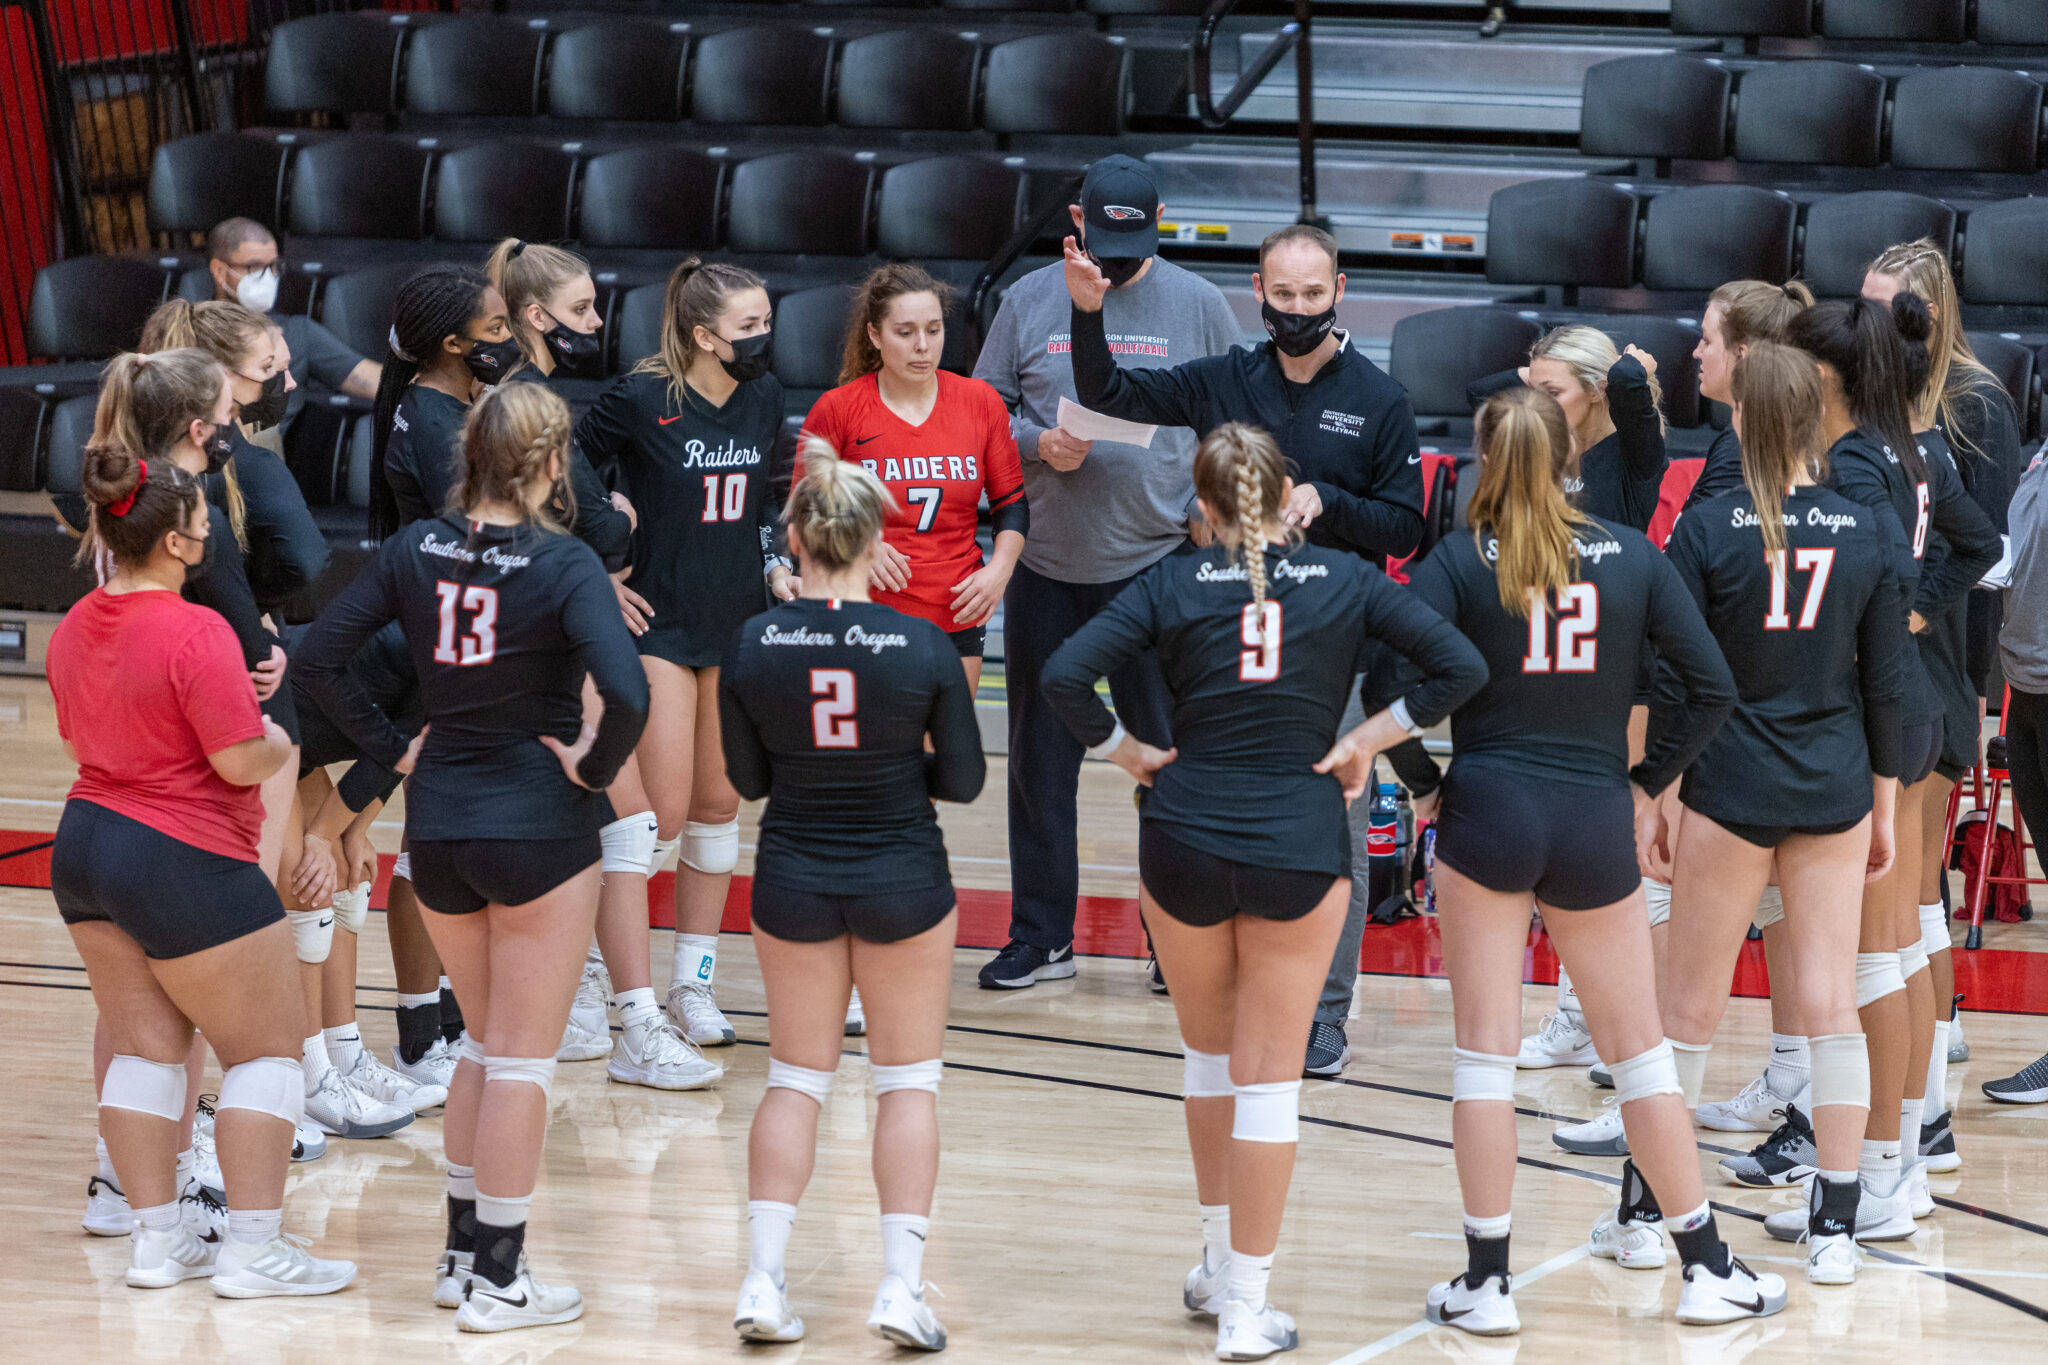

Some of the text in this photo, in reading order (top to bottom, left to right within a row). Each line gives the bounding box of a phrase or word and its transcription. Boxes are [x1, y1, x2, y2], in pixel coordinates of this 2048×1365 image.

[1047, 342, 1169, 357] RAID VOLLEYBALL
[1124, 334, 1169, 345] UNIVERSITY
[1319, 423, 1361, 437] VOLLEYBALL
[1321, 413, 1364, 427] UNIVERSITY
[683, 439, 761, 468] Raiders
[861, 455, 978, 481] RAIDERS
[701, 472, 748, 523] 10
[907, 486, 944, 533] 7
[1806, 506, 1857, 534] Oregon
[419, 533, 532, 575] Southern Oregon
[1196, 559, 1330, 584] Southe Oregon
[1764, 547, 1836, 630] 17
[434, 580, 499, 667] 13
[1521, 580, 1600, 674] 12
[760, 624, 909, 655] Southern Oregon
[1238, 598, 1283, 682] 9
[809, 667, 859, 748] 2
